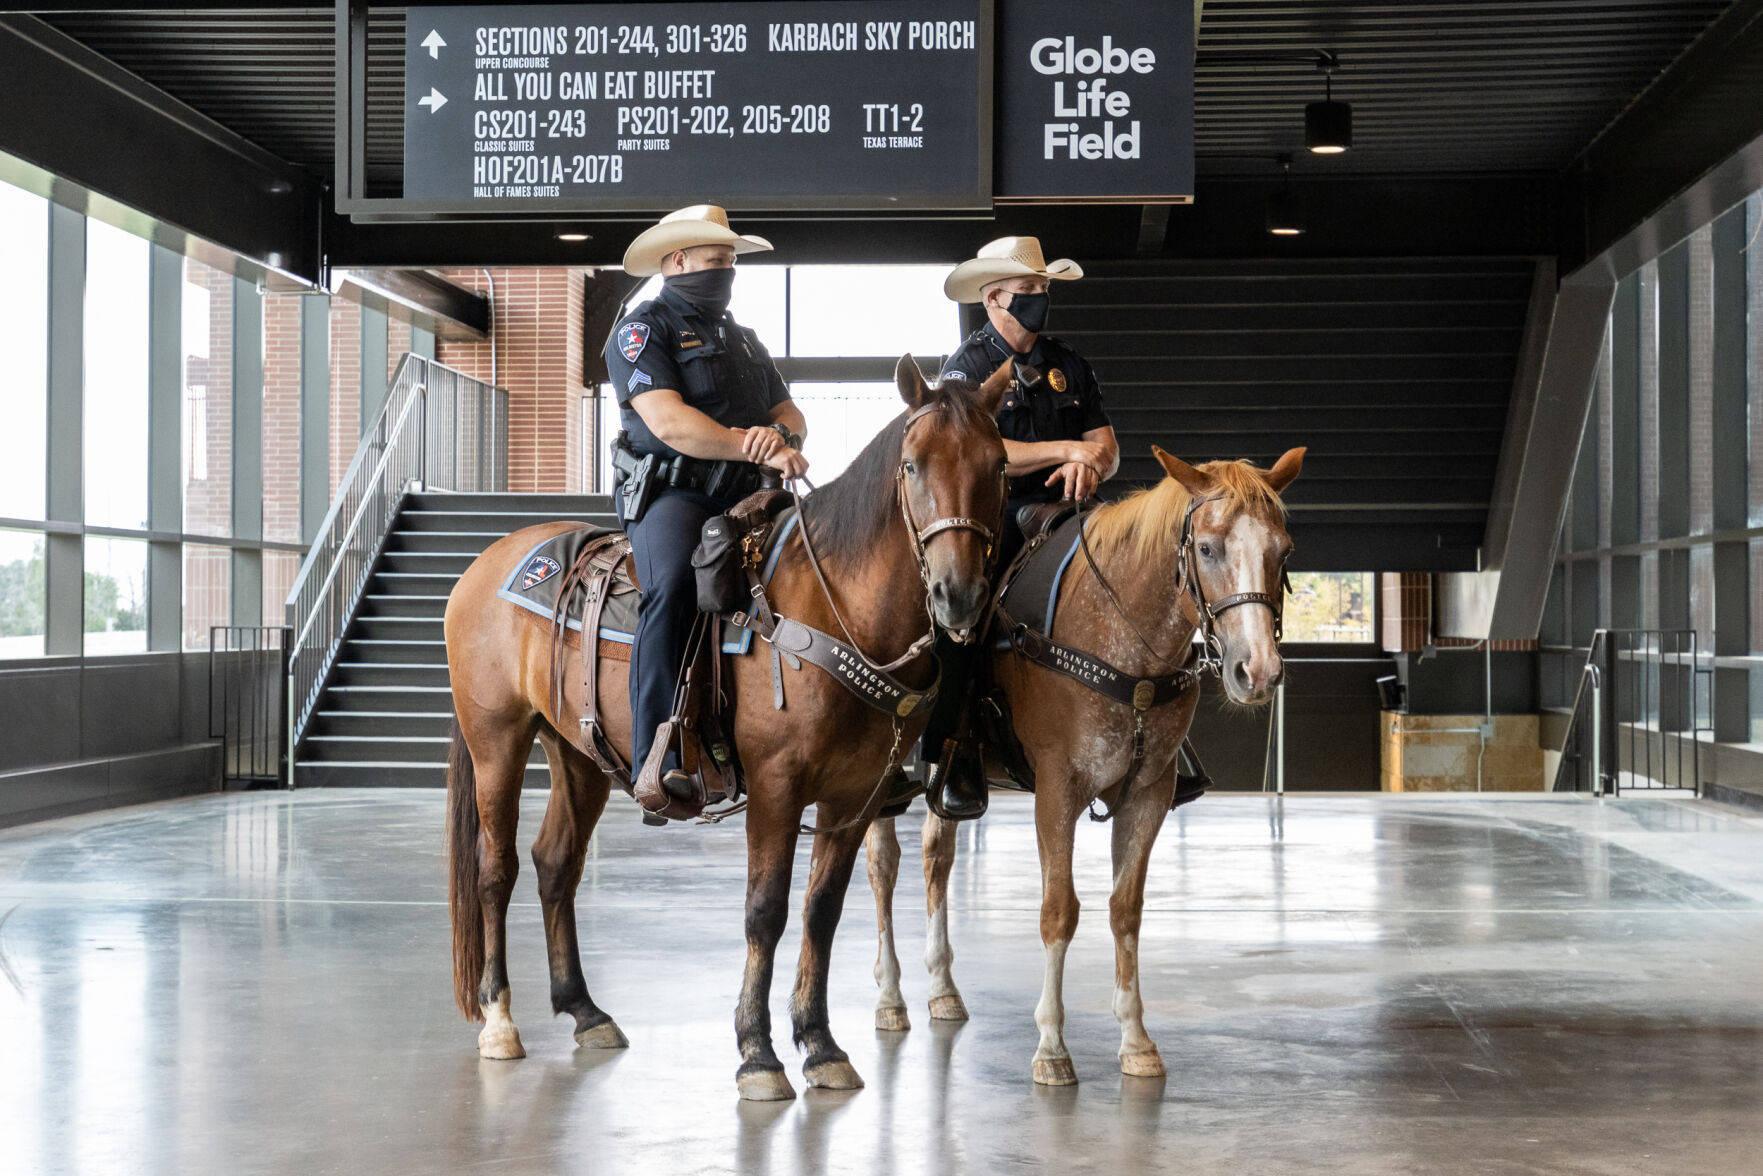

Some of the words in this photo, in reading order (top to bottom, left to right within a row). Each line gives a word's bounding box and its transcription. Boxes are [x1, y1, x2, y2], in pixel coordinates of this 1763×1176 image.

[475, 26, 568, 56] SECTIONS
[574, 25, 659, 58] 201-244,
[666, 23, 747, 53] 301-326
[768, 22, 858, 52] KARBACH
[864, 21, 902, 51] SKY
[908, 20, 975, 50] PORCH
[475, 58, 500, 70] UPPER
[502, 57, 550, 69] CONCOURSE
[1029, 35, 1156, 75] Globe
[474, 72, 509, 102] ALL
[513, 71, 552, 101] YOU
[559, 71, 598, 101] CAN
[604, 70, 638, 100] EAT
[644, 69, 716, 100] BUFFET
[1054, 77, 1131, 118] Life
[474, 108, 586, 139] CS201-243
[617, 105, 735, 138] PS201-202,
[742, 104, 831, 134] 205-208
[862, 103, 924, 133] TT1-2
[474, 140, 506, 153] CLASSIC
[508, 139, 535, 152] SUITES
[617, 139, 641, 151] PARTY
[643, 138, 670, 151] SUITES
[862, 136, 887, 149] TEXAS
[888, 136, 923, 148] TERRACE
[1044, 120, 1141, 160] Field
[473, 154, 623, 185] HOF201A-207B
[473, 186, 492, 198] HALL
[494, 186, 505, 198] OF
[506, 186, 532, 197] FAMES
[533, 185, 560, 197] SUITES
[620, 324, 648, 336] POLICE
[536, 557, 558, 571] POLICE
[831, 646, 900, 698] ARLINGTON
[1050, 645, 1118, 681] ARLINGTON
[1056, 657, 1101, 684] POLICE
[838, 663, 883, 700] POLICE
